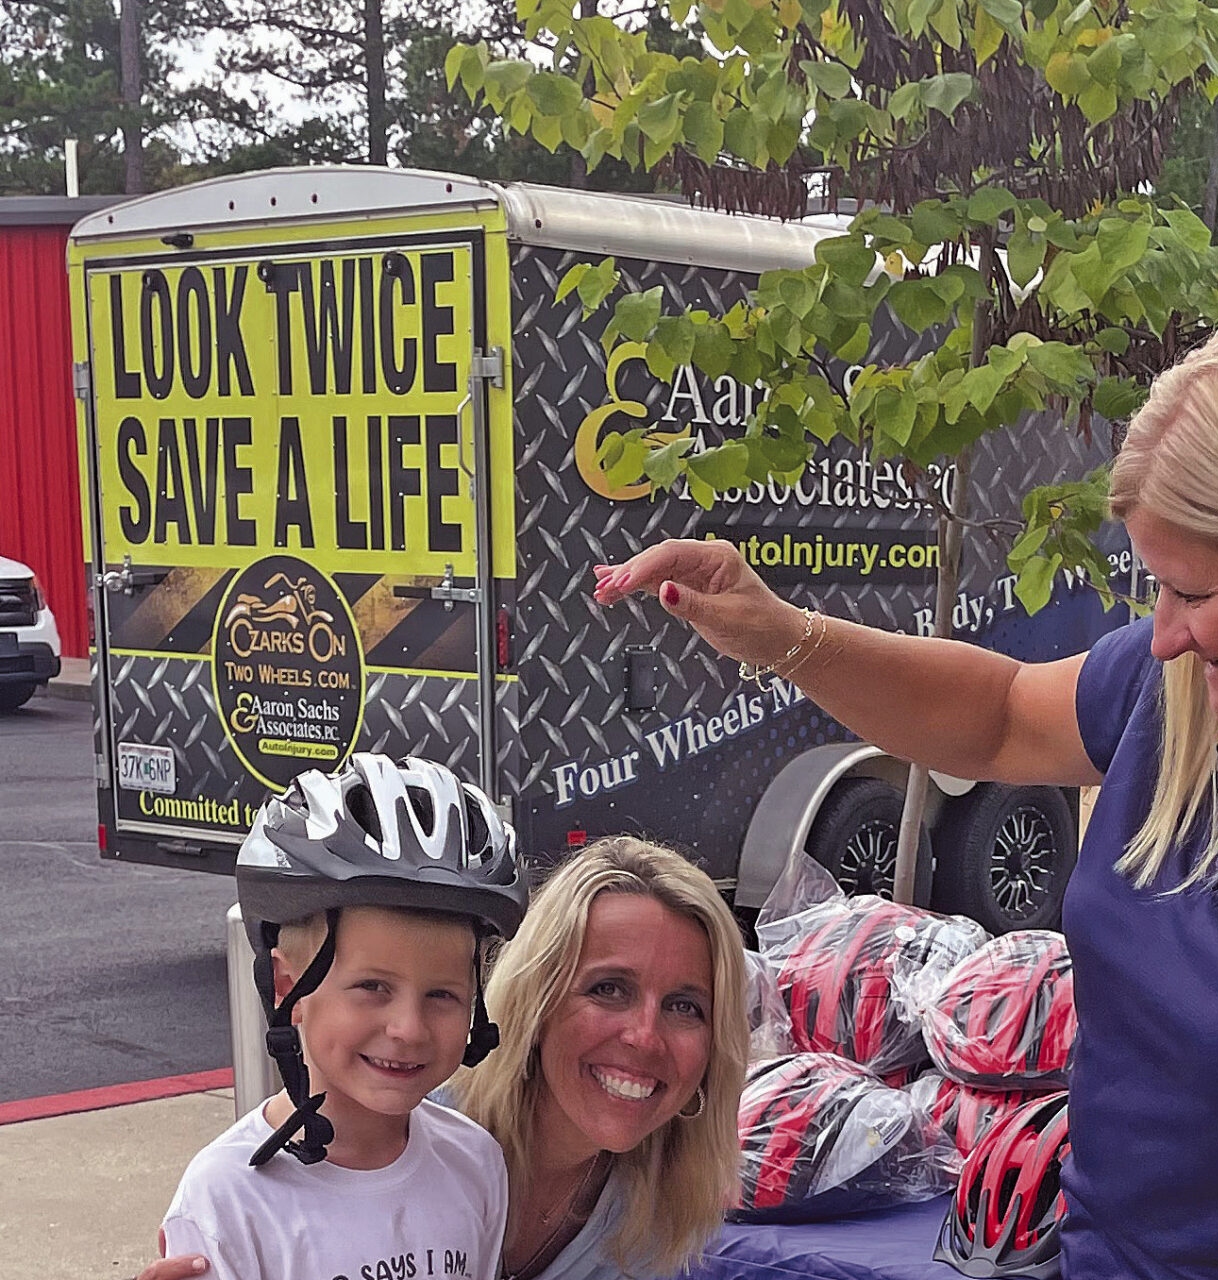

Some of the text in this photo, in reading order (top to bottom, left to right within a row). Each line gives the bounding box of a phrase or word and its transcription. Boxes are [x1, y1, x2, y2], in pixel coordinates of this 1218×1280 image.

[110, 251, 458, 400] LOOK TWICE
[116, 414, 463, 553] SAVE A LIFE
[913, 591, 994, 637] Bdy,
[250, 695, 340, 721] Aaron Sachs
[551, 750, 640, 806] Four
[644, 693, 765, 768] Wheels
[139, 789, 240, 826] Committed
[426, 1249, 434, 1276] I
